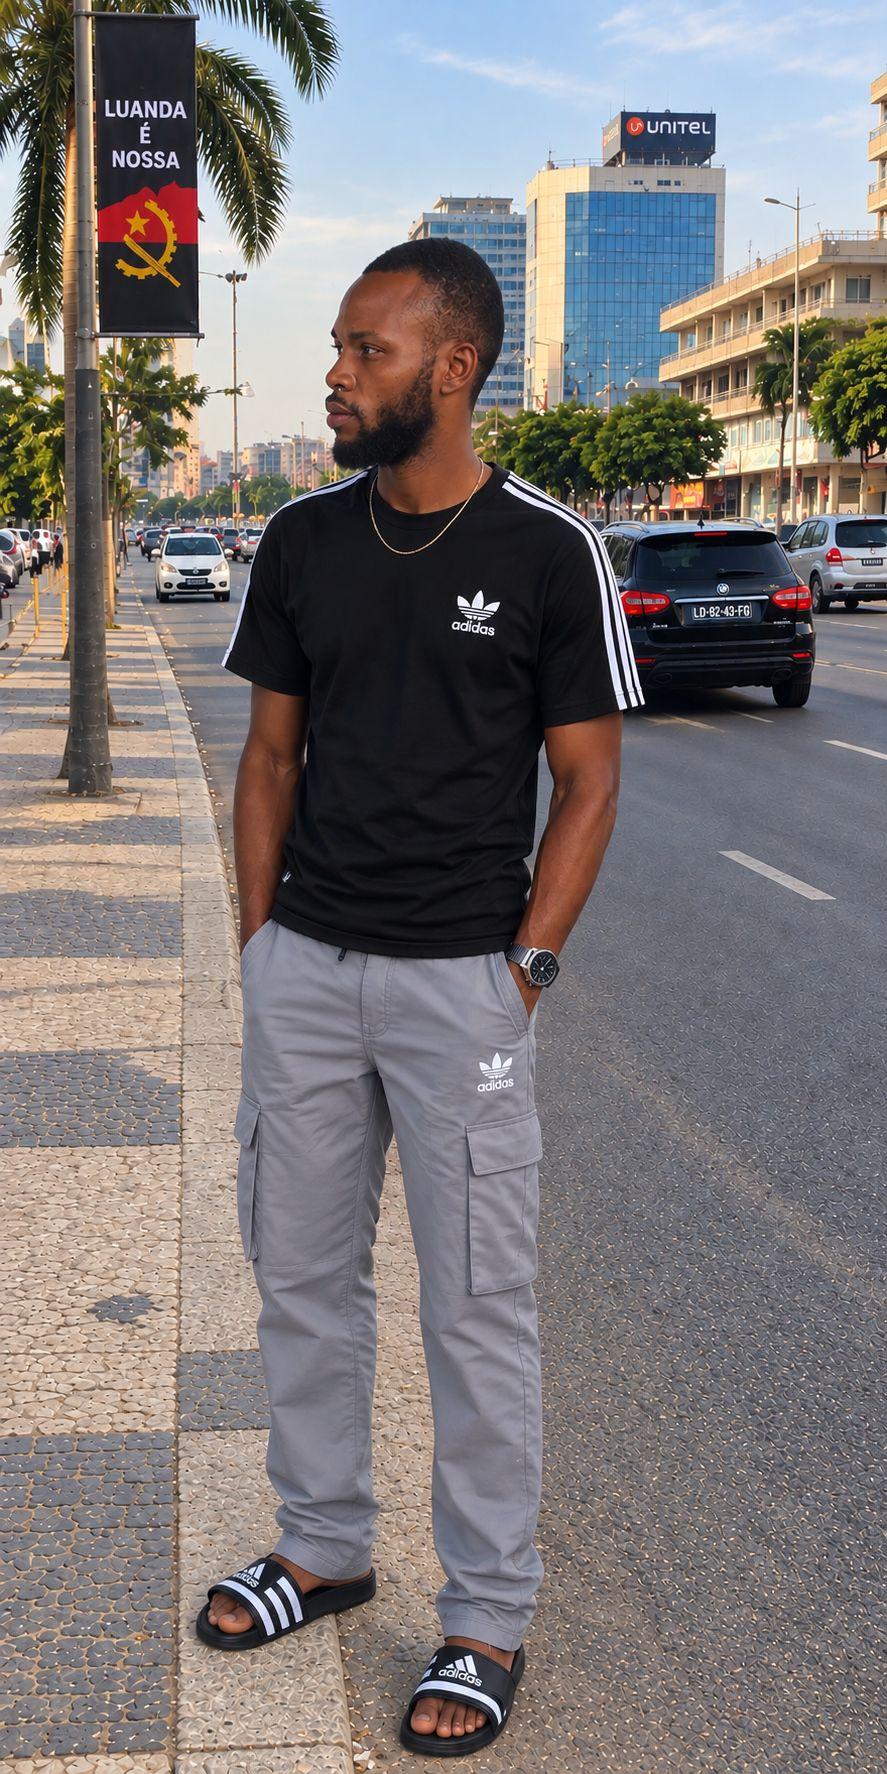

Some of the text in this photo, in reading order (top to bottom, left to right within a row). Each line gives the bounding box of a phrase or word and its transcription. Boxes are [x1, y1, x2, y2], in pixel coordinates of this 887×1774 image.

[105, 100, 187, 119] LUANDA
[140, 122, 151, 144] É
[647, 121, 711, 135] UNITEL
[112, 150, 180, 169] NOSSA
[451, 620, 495, 636] adidas
[477, 1078, 514, 1092] adidas
[438, 1667, 483, 1687] adidas
